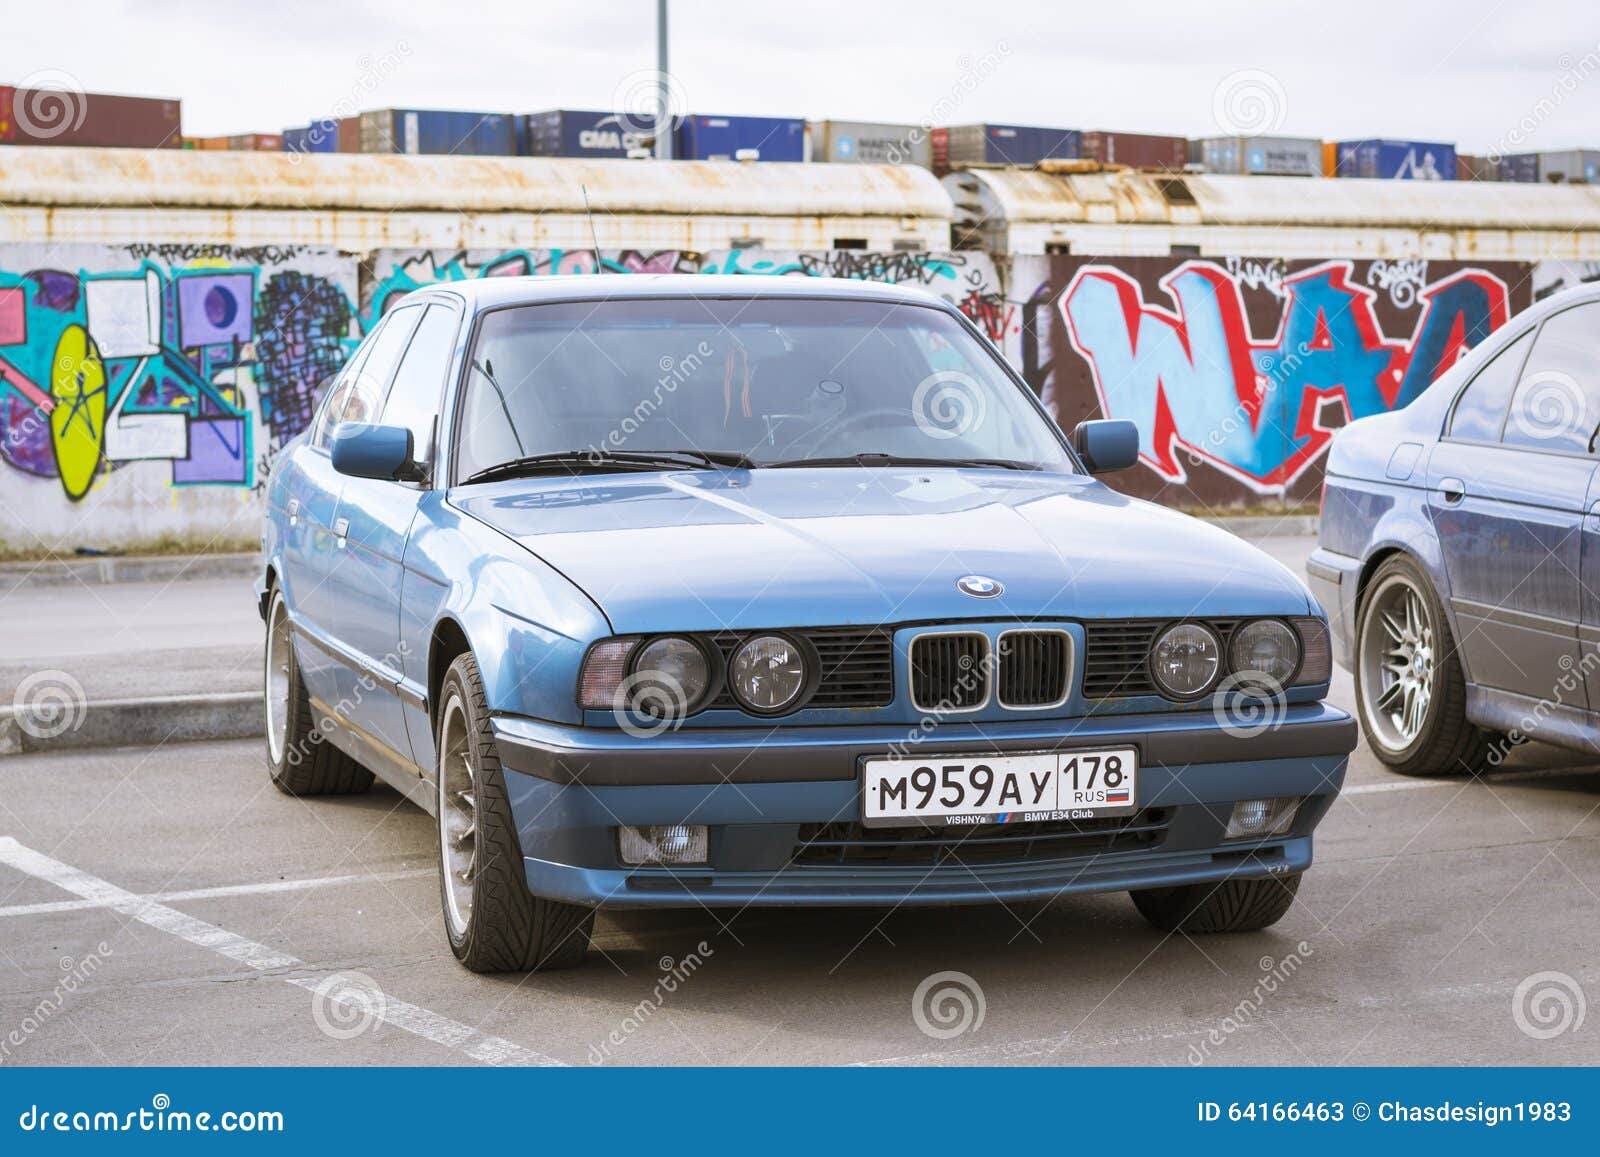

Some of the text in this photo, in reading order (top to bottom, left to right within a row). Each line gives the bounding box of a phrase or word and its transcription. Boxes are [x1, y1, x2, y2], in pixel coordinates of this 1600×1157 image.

[1063, 755, 1123, 790] 178
[1074, 790, 1105, 803] RUS
[1024, 812, 1050, 822] BMW
[1051, 811, 1070, 821] E34
[1071, 809, 1094, 819] Club
